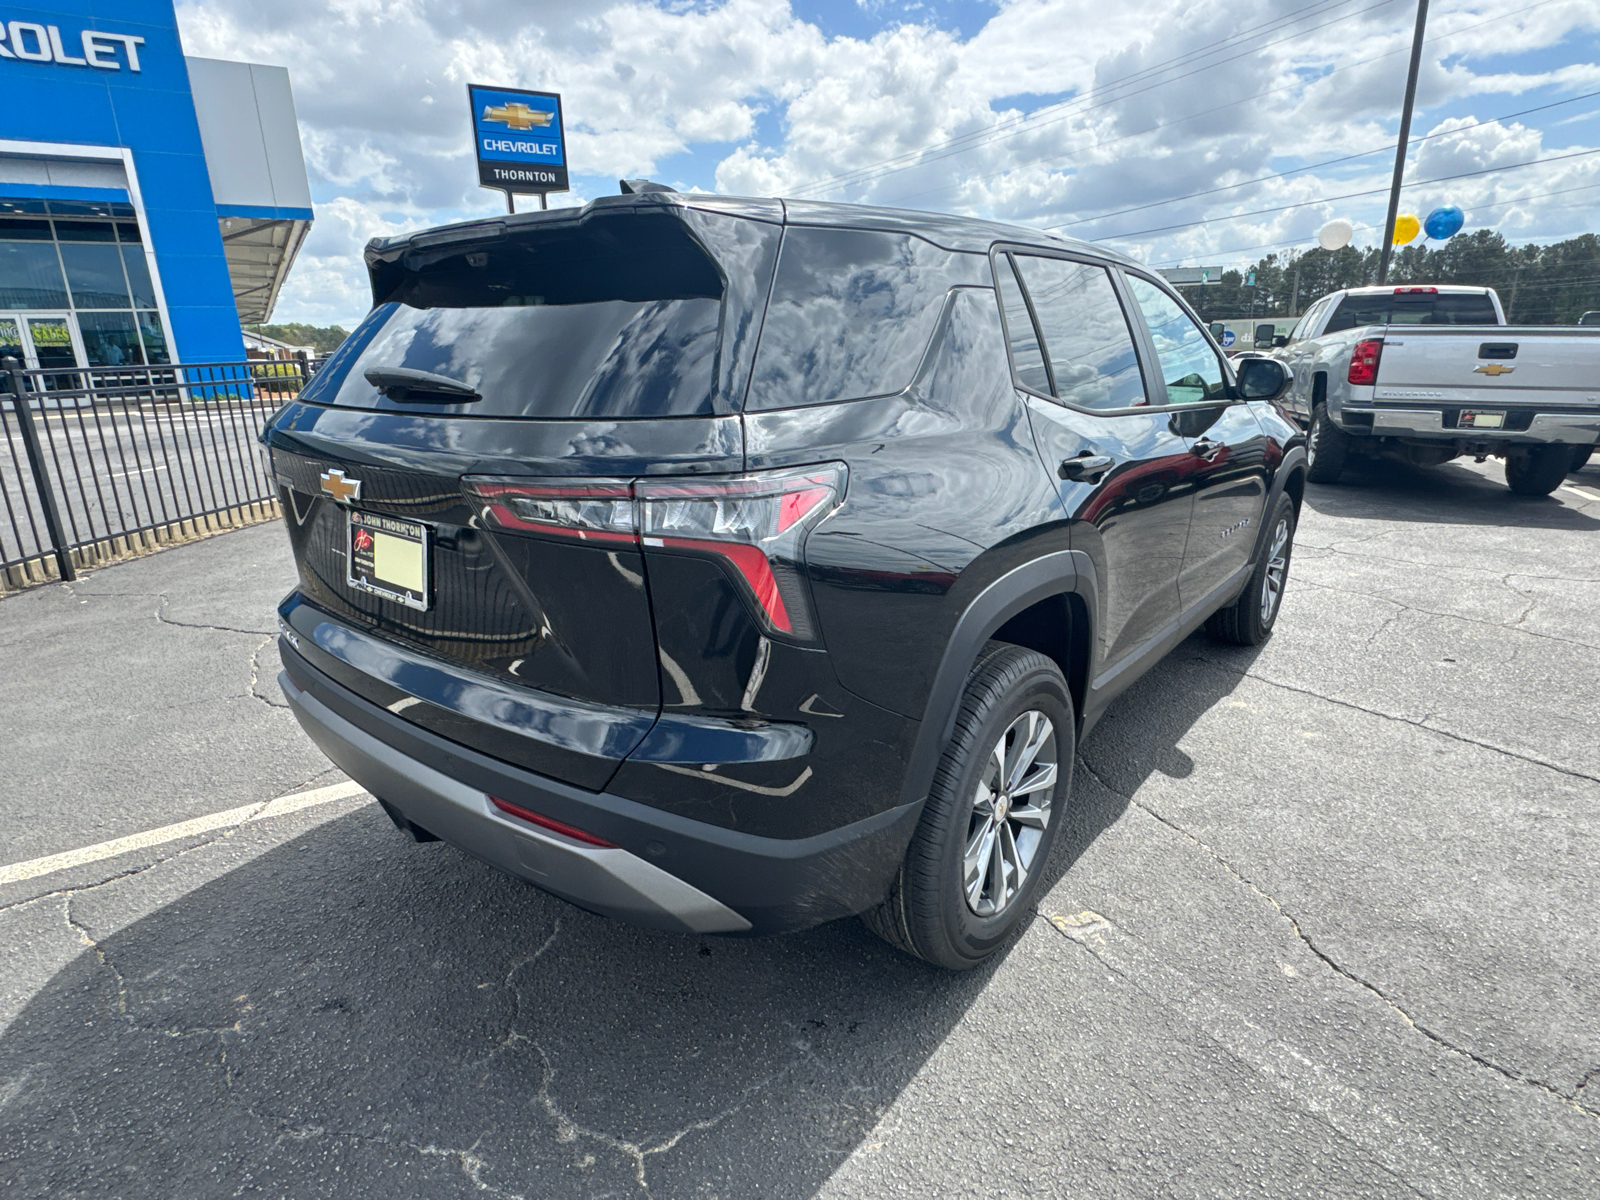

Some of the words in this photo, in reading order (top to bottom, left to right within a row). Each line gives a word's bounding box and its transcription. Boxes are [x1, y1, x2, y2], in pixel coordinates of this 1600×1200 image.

[483, 139, 557, 155] CHEVROLET
[493, 169, 556, 182] THORNTON
[363, 514, 381, 527] JOHN
